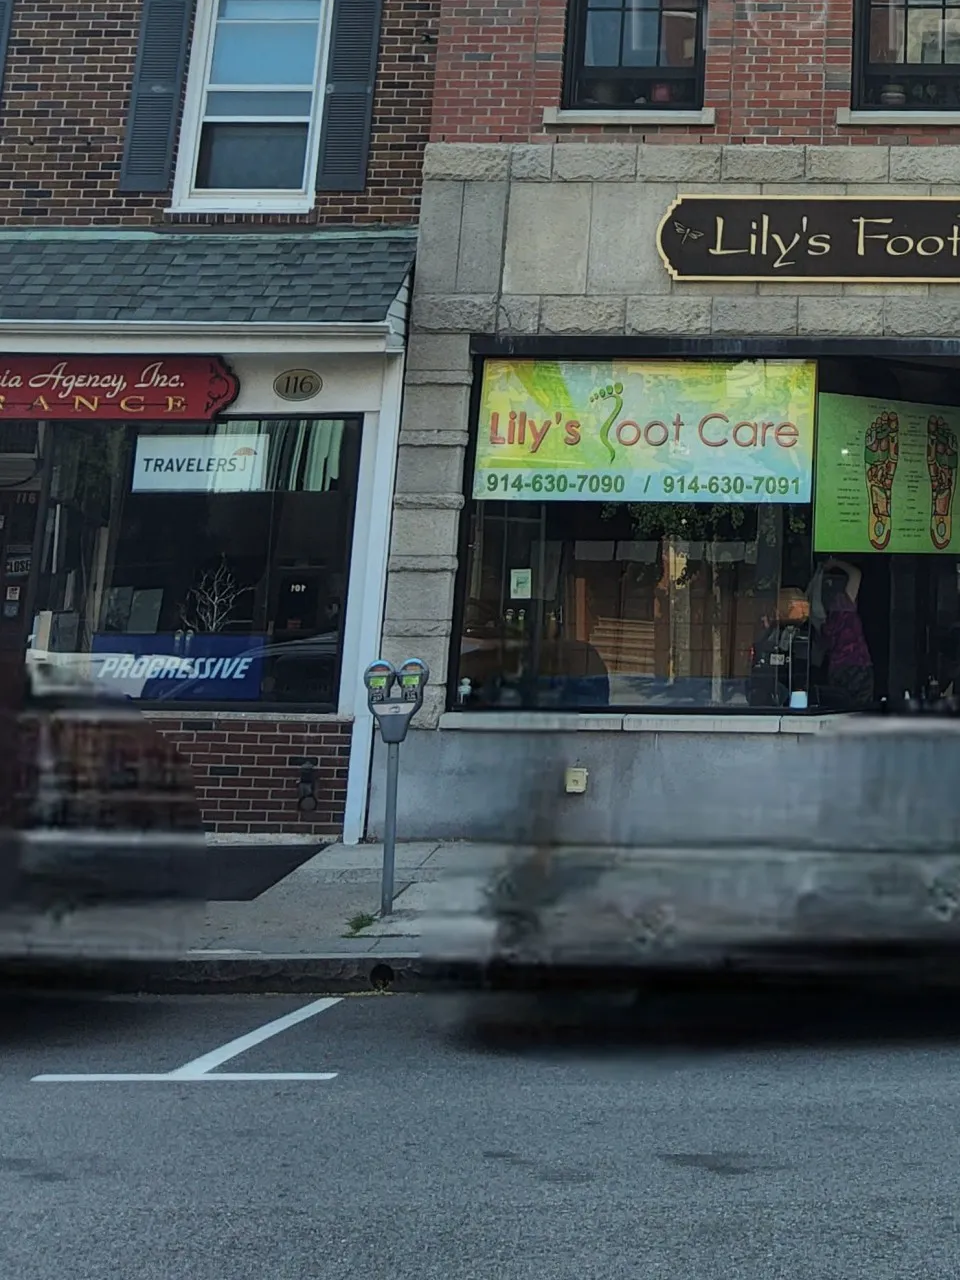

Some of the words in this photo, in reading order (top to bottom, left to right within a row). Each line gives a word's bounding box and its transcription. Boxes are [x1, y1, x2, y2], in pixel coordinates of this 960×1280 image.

[708, 214, 831, 268] Lily's
[0, 370, 23, 388] ia
[29, 362, 127, 399] Agency,
[134, 361, 185, 388] Inc.
[285, 375, 314, 393] 116
[489, 411, 581, 453] Lily's
[698, 412, 800, 448] Care
[143, 457, 238, 473] TRAVELERS
[486, 473, 625, 494] 914-630-7090
[643, 474, 652, 494] /
[663, 475, 801, 495] 914-630-7091
[97, 656, 253, 680] PROGRESSIVE
